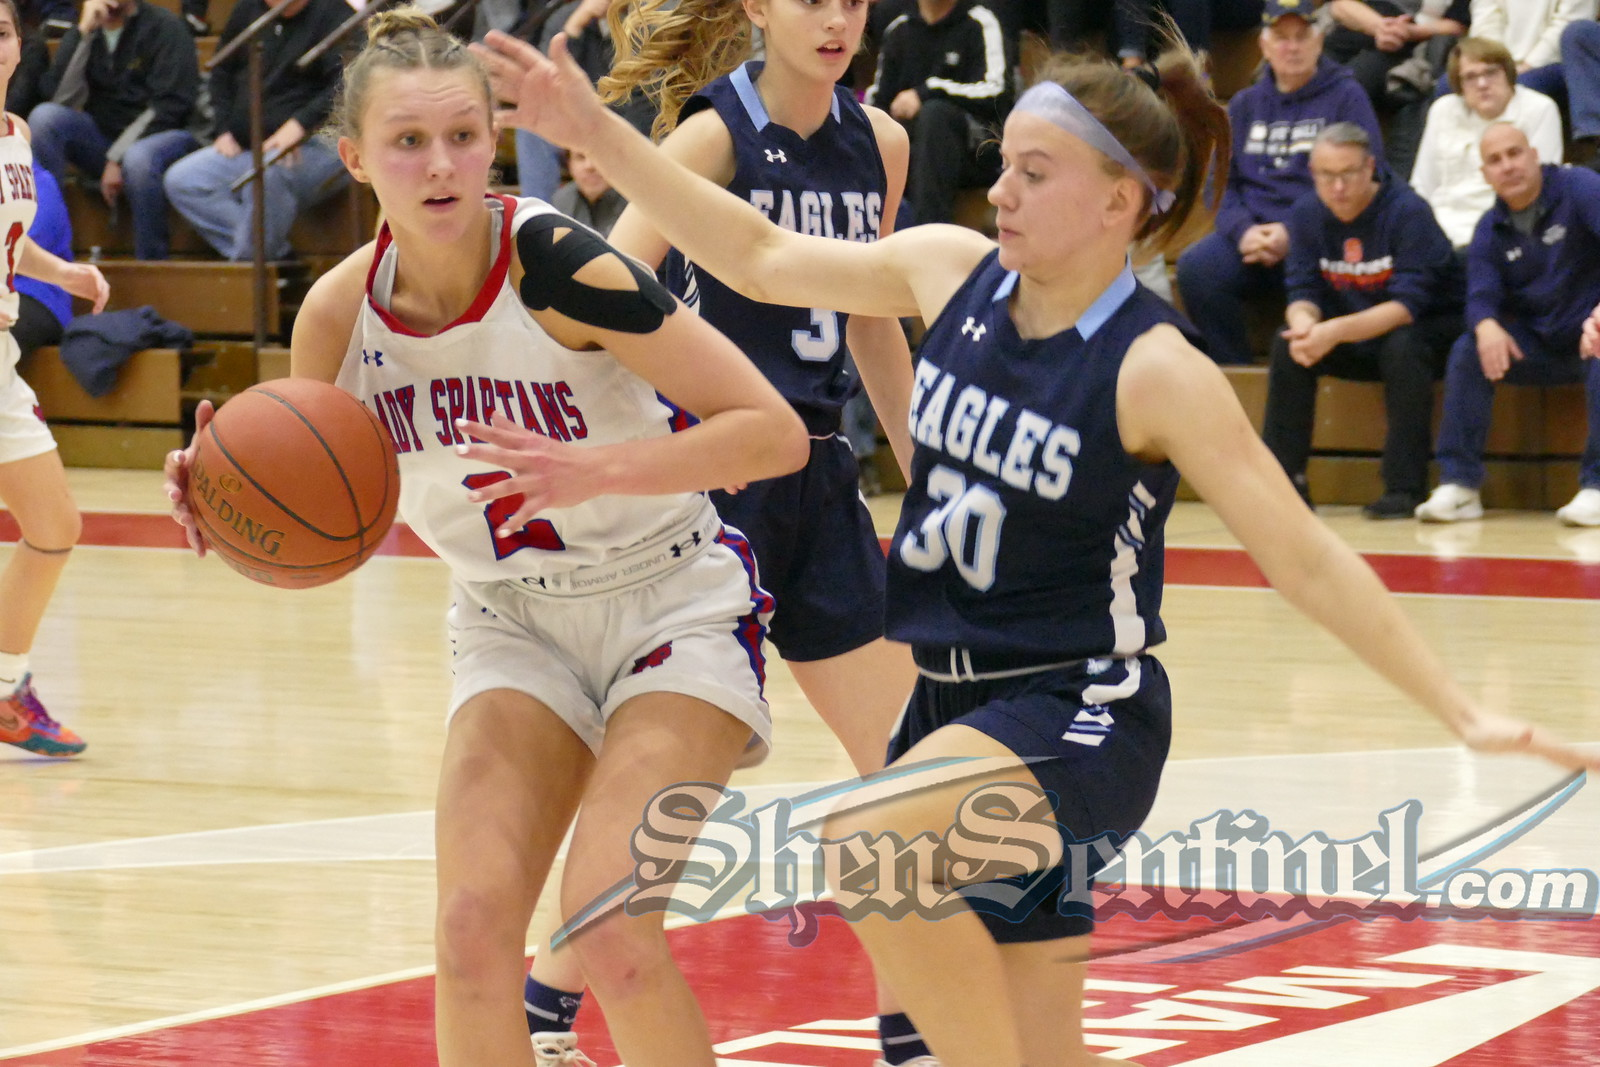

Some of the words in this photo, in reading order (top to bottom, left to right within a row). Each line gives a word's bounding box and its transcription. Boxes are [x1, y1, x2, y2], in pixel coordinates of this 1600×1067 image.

[373, 384, 424, 454] ADY
[430, 376, 588, 447] SPARTANS
[908, 357, 1081, 501] EAGLES
[194, 462, 286, 556] PALDING
[461, 470, 566, 561] 2
[901, 463, 1006, 592] 30
[622, 552, 667, 574] UNDER
